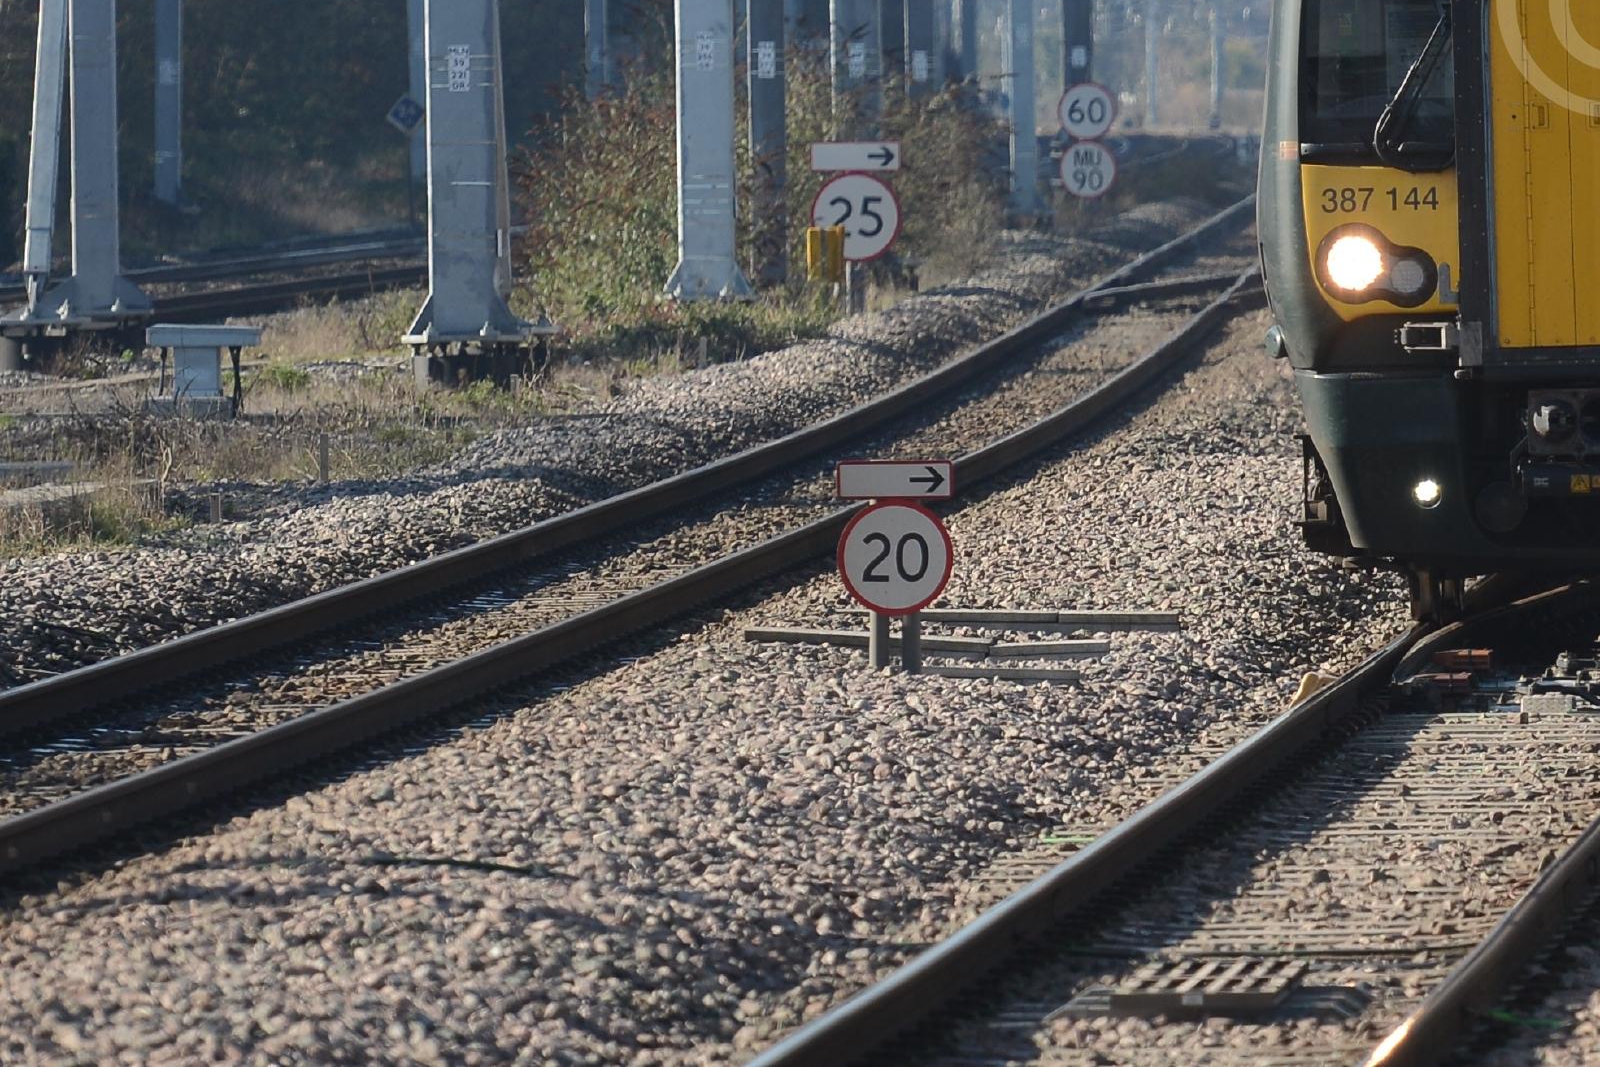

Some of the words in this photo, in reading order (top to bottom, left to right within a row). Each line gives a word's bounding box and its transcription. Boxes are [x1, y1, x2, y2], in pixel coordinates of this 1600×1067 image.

[1068, 97, 1105, 124] 60
[1071, 168, 1103, 190] 90
[1321, 187, 1375, 214] 387
[1385, 186, 1439, 212] 144
[829, 196, 884, 237] 25
[862, 532, 929, 582] 20
